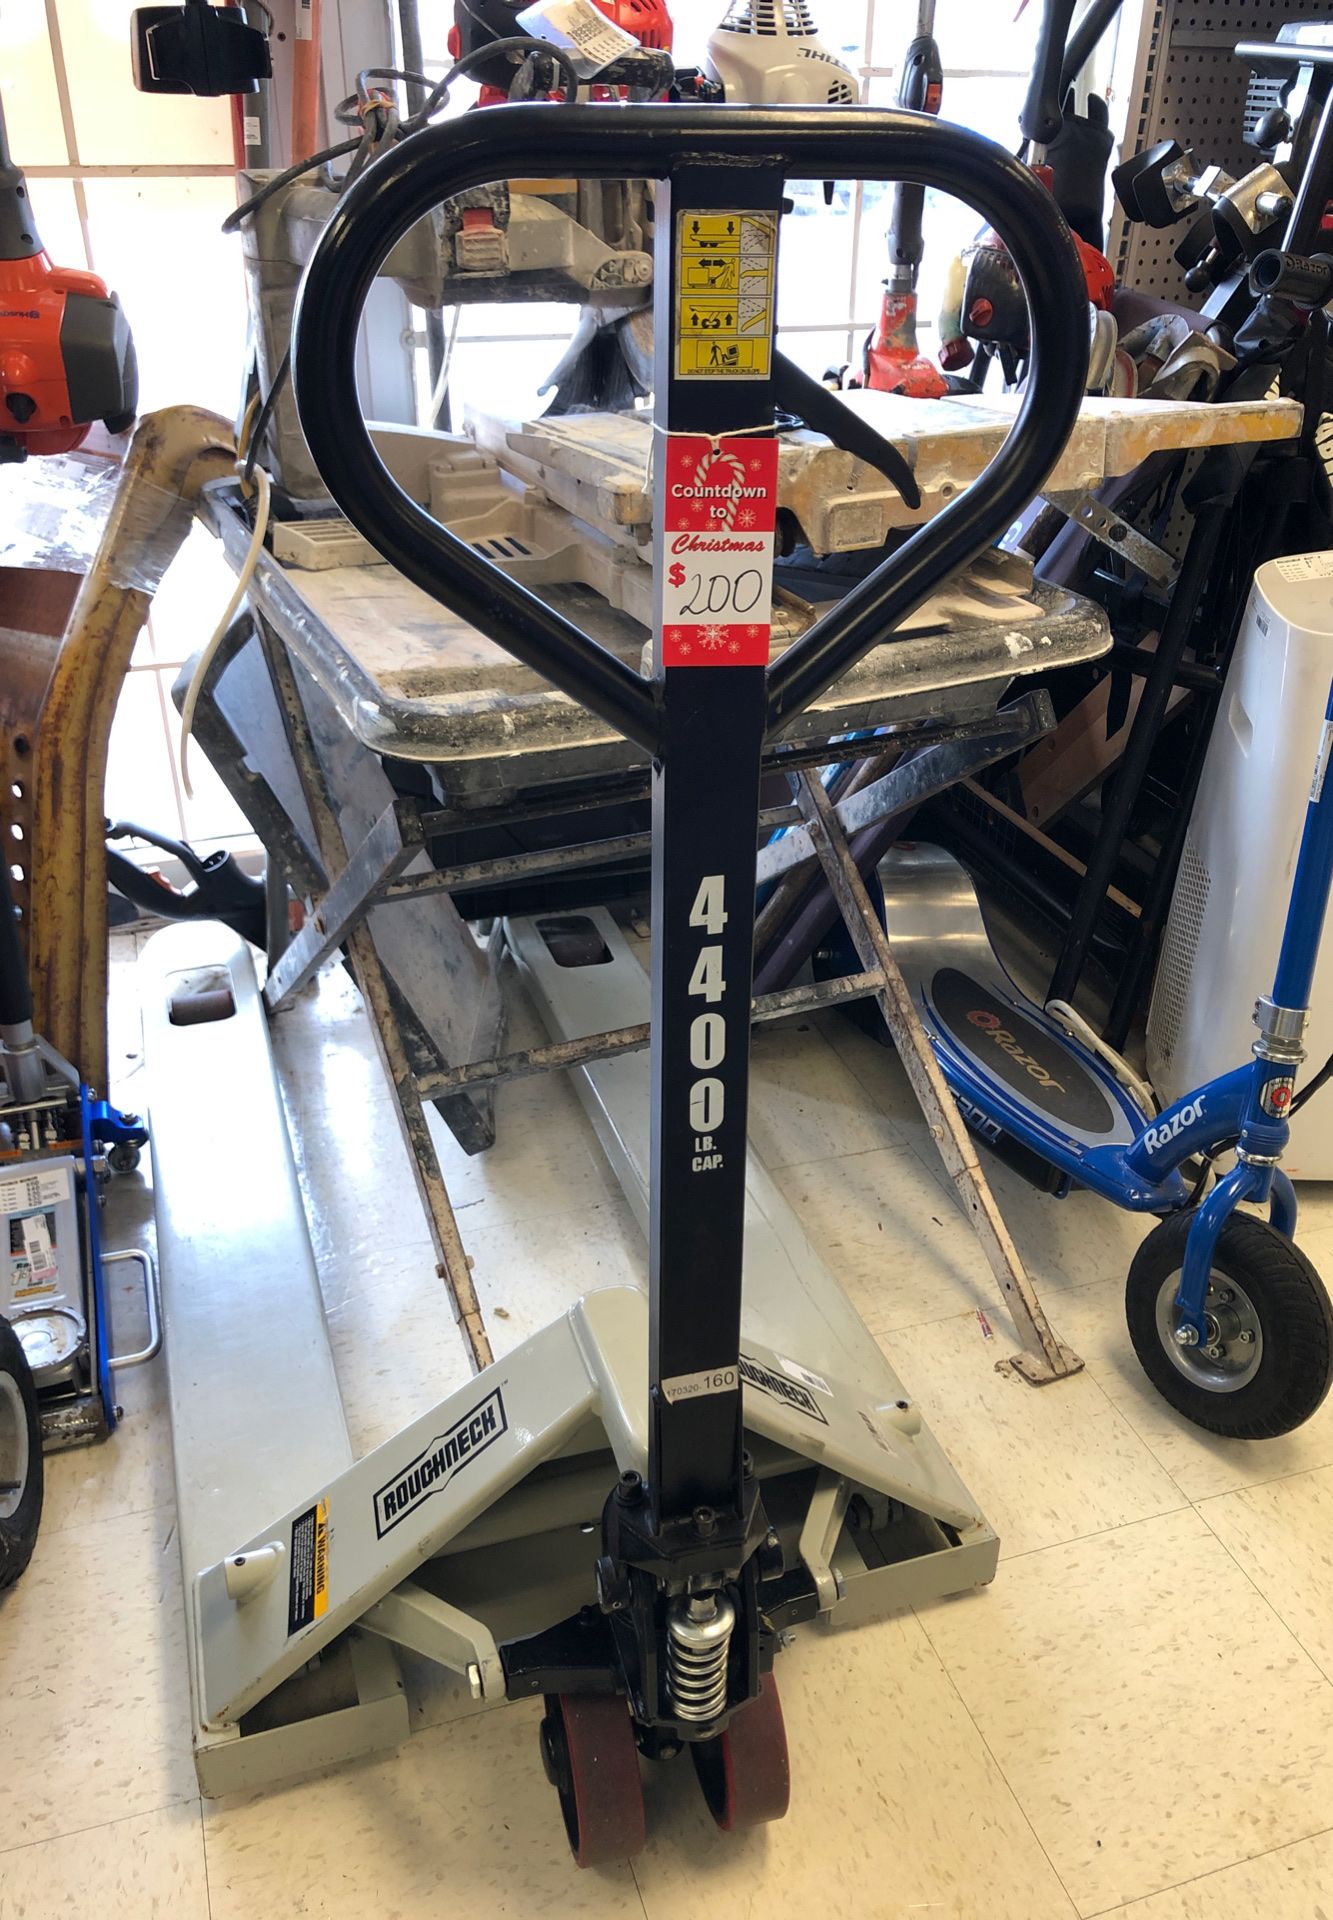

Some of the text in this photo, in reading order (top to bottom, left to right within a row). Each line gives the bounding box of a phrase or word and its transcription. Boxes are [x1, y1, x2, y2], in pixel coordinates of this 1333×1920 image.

[671, 483, 767, 498] Countdown
[710, 505, 727, 518] to
[671, 533, 765, 555] Christmas
[679, 569, 763, 616] 200
[985, 1029, 1067, 1094] Razor
[695, 1136, 717, 1152] LB.
[1143, 1094, 1206, 1155] Razor
[692, 1154, 724, 1172] CAP.
[739, 1359, 817, 1414] UGHNECK
[383, 1404, 497, 1522] ROUGHNECK
[316, 1535, 326, 1595] WARNING
